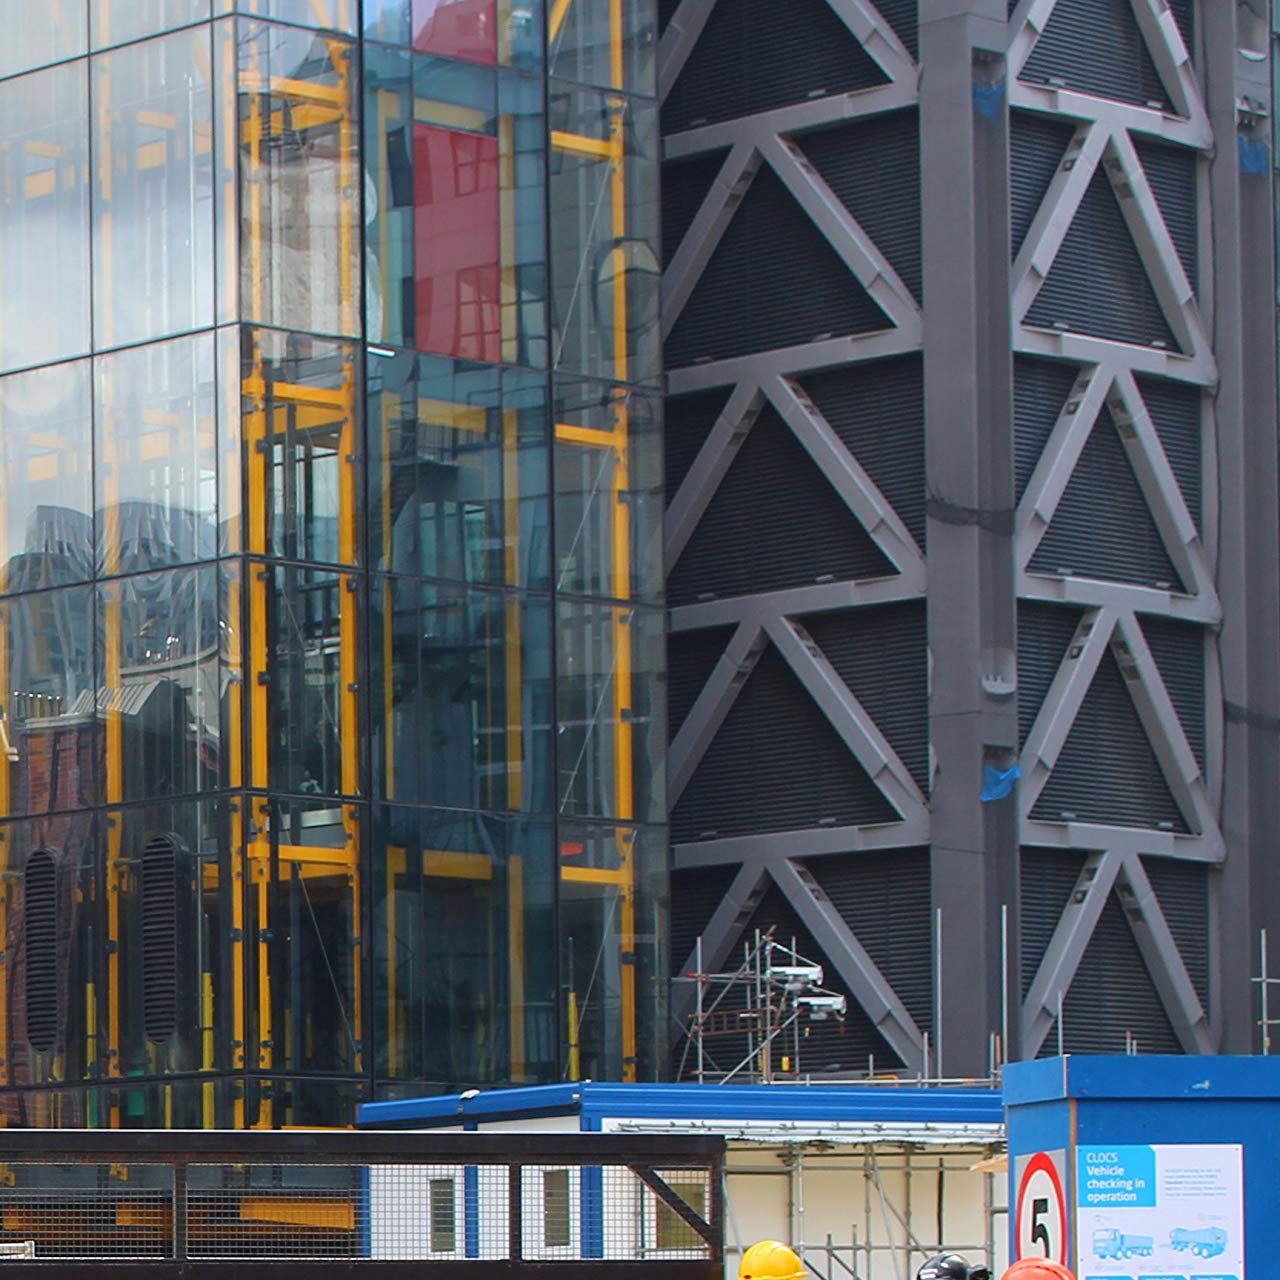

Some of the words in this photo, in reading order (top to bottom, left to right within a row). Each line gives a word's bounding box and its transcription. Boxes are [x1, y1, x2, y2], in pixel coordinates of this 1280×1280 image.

[1086, 1152, 1118, 1163] CLOCS
[1086, 1165, 1125, 1176] Vehicle
[1087, 1178, 1133, 1191] checking
[1135, 1178, 1145, 1188] in
[1087, 1191, 1137, 1204] operation
[1032, 1198, 1050, 1259] 5
